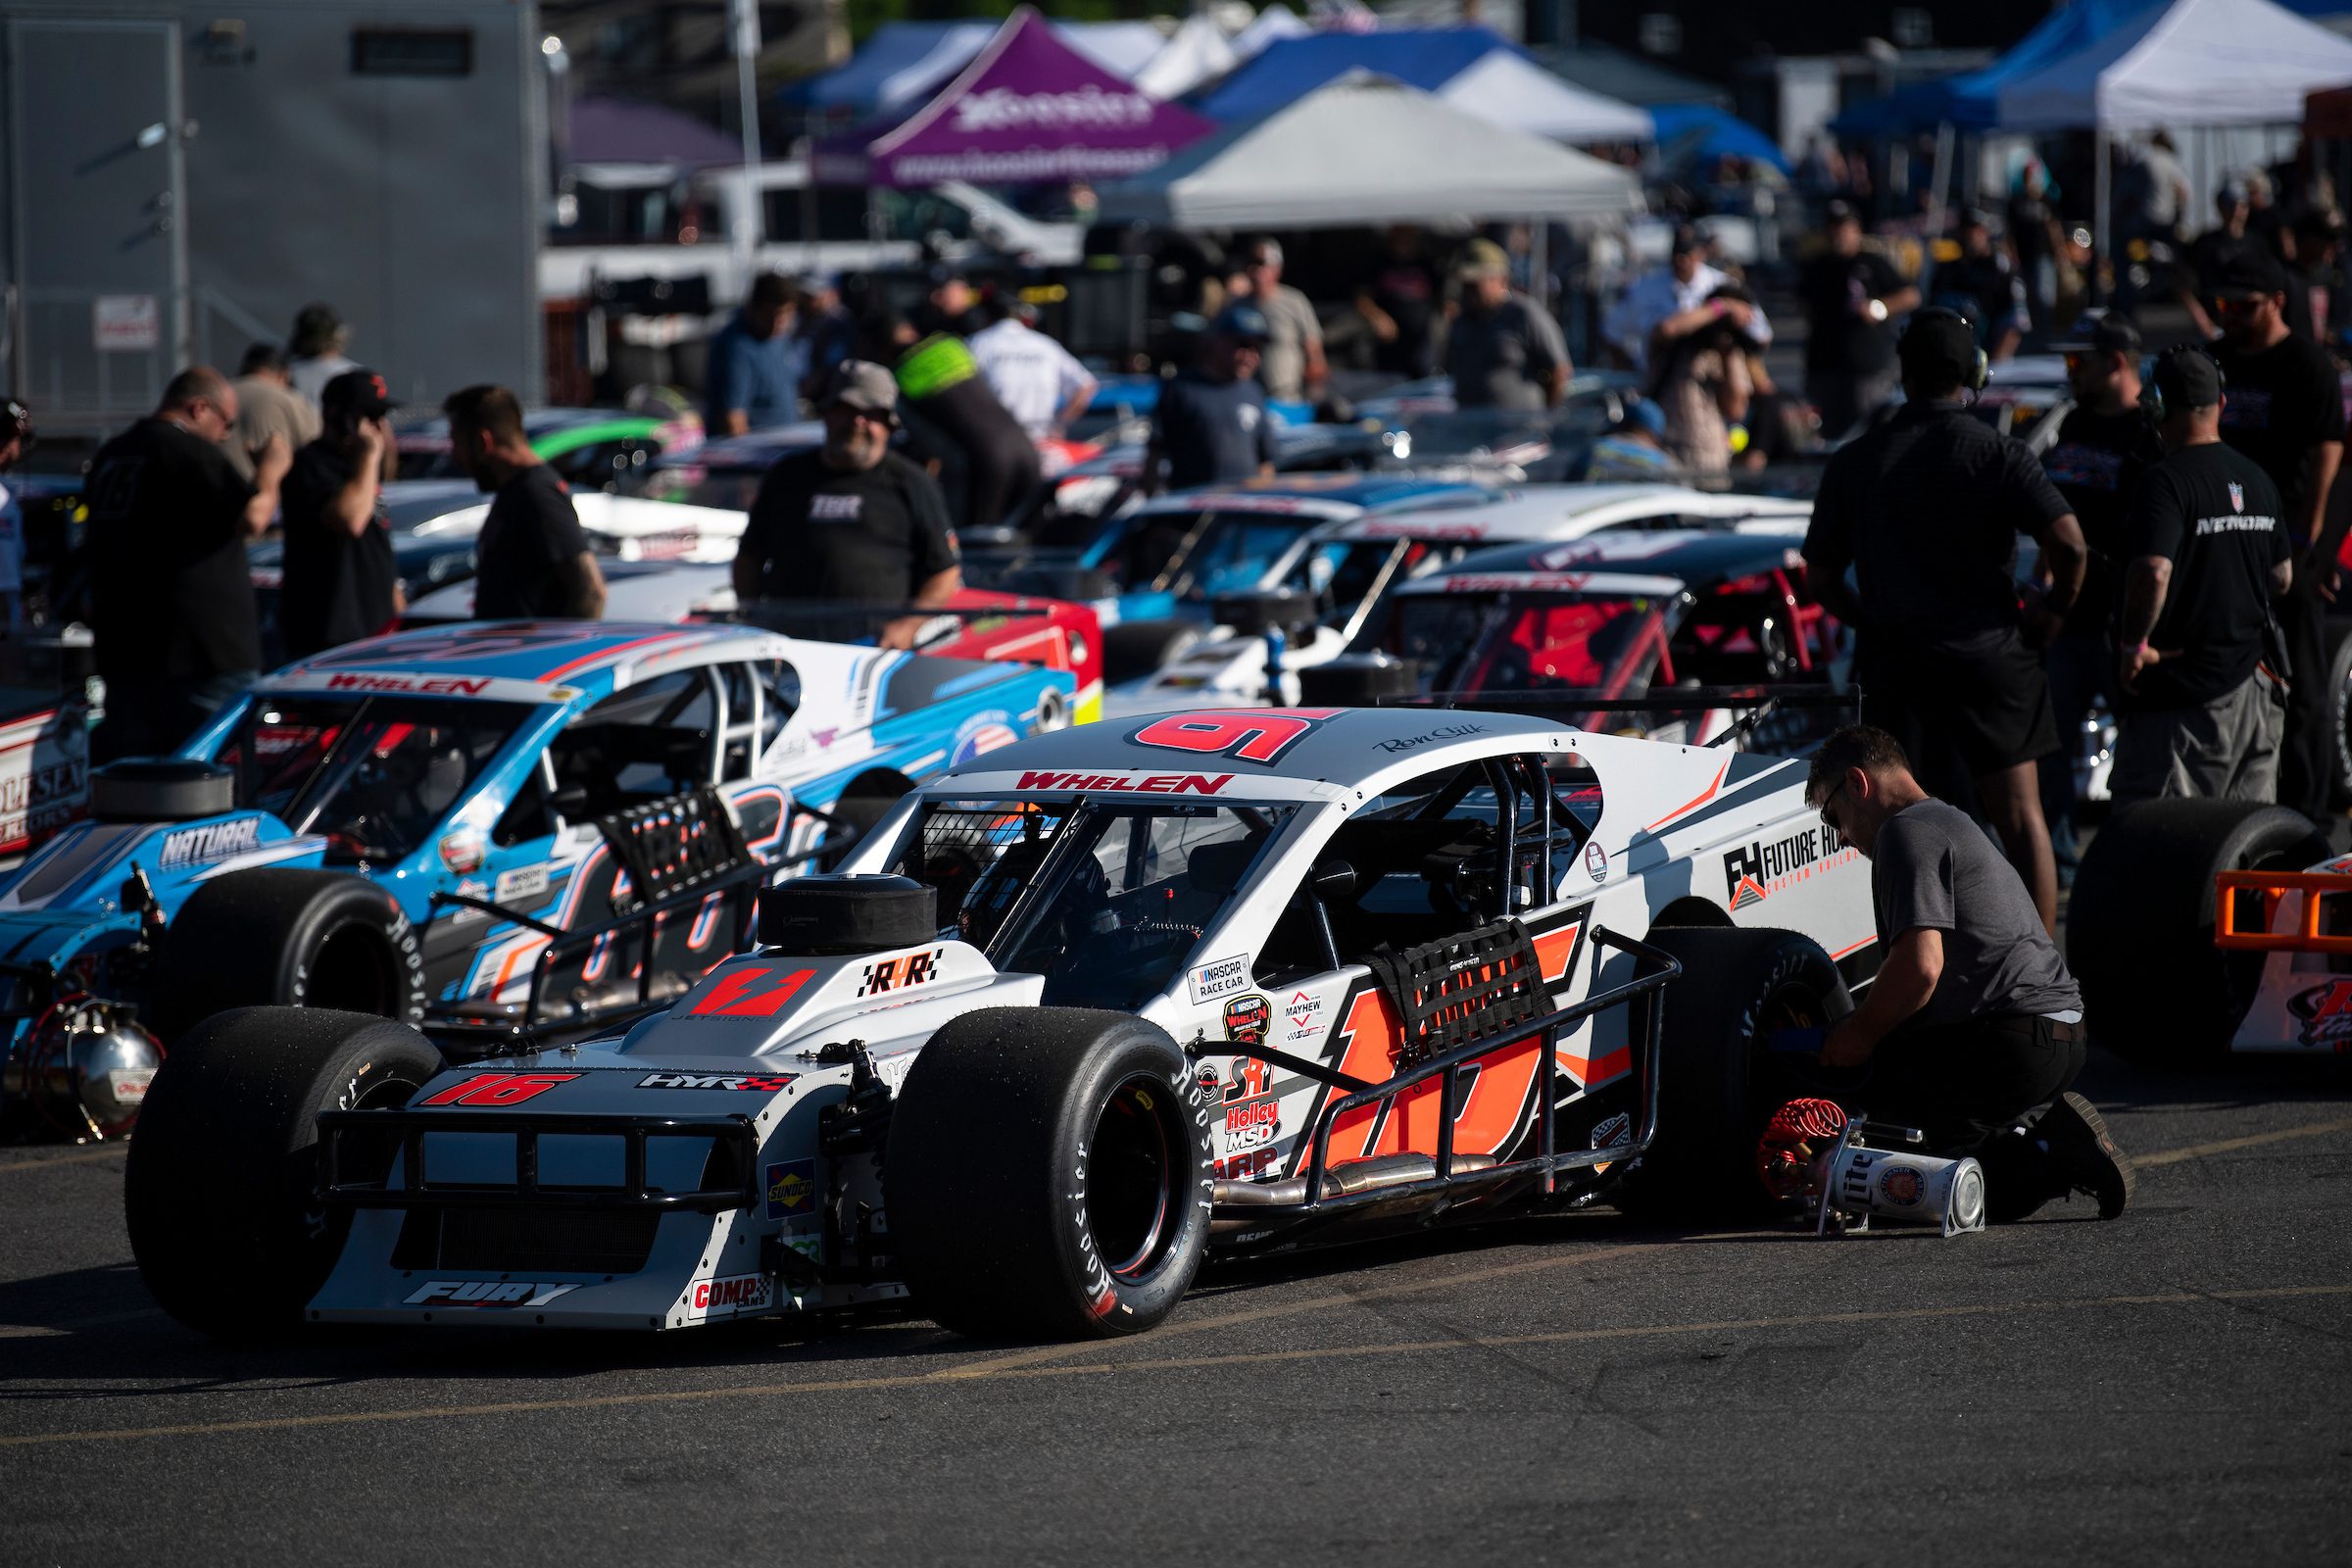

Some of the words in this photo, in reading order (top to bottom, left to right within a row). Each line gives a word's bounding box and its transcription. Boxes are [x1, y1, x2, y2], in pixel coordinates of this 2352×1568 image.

[326, 672, 493, 696] WHELEN
[1015, 771, 1237, 796] WHELEN
[160, 815, 262, 867] NATURAL
[1763, 828, 1818, 879] FUTURE
[1766, 867, 1811, 895] CUSTOM
[1819, 849, 1858, 873] BUILDE
[1200, 960, 1242, 983] NASCAR
[1200, 983, 1224, 997] RACE
[1225, 976, 1244, 989] CAR
[1237, 999, 1261, 1012] NASCAR
[1285, 1001, 1321, 1017] MAYHEW
[414, 1072, 588, 1107] 16
[637, 1074, 742, 1091] HYR
[1226, 1101, 1279, 1133] Holley
[1170, 1051, 1216, 1219] Hoosier
[1226, 1125, 1275, 1152] MSD
[1213, 1148, 1278, 1180] ARP
[769, 1181, 813, 1201] SUNOCO
[1843, 1153, 1875, 1211] Lite
[1067, 1142, 1115, 1306] Hoosier
[401, 1281, 585, 1307] FURY
[695, 1278, 748, 1309] COMP
[736, 1296, 766, 1308] CAMS
